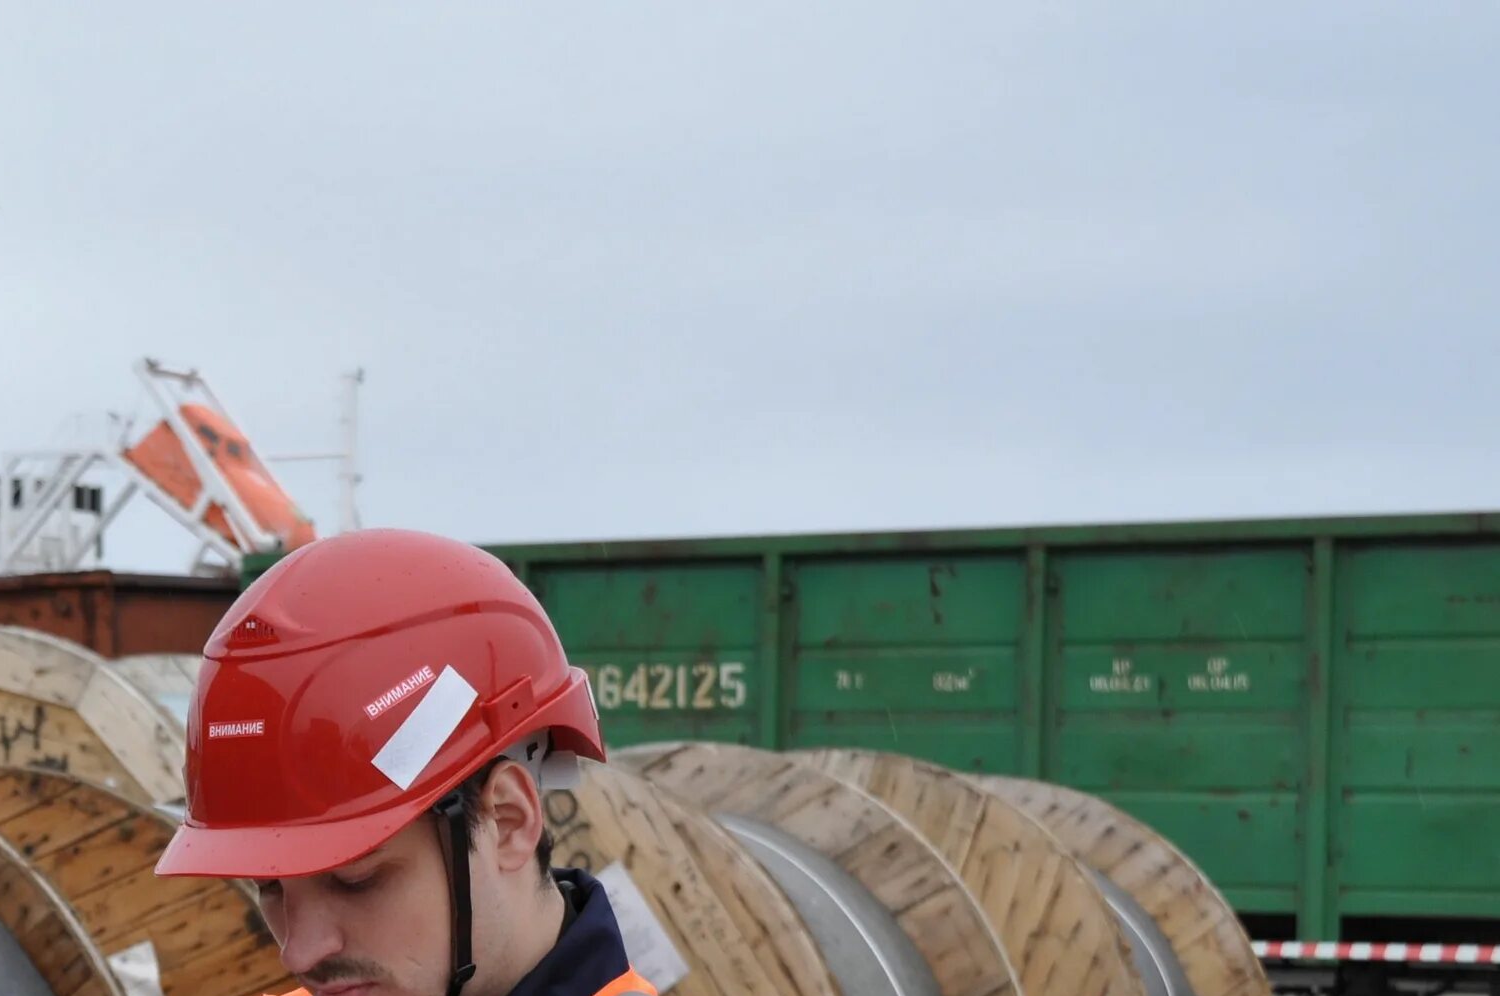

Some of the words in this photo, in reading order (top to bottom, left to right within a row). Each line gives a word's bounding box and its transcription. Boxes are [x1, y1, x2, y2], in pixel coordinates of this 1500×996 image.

[366, 666, 434, 718] ВНИМАНИЕ
[588, 661, 747, 709] 642125
[209, 722, 264, 738] ВНИМАНИЕ
